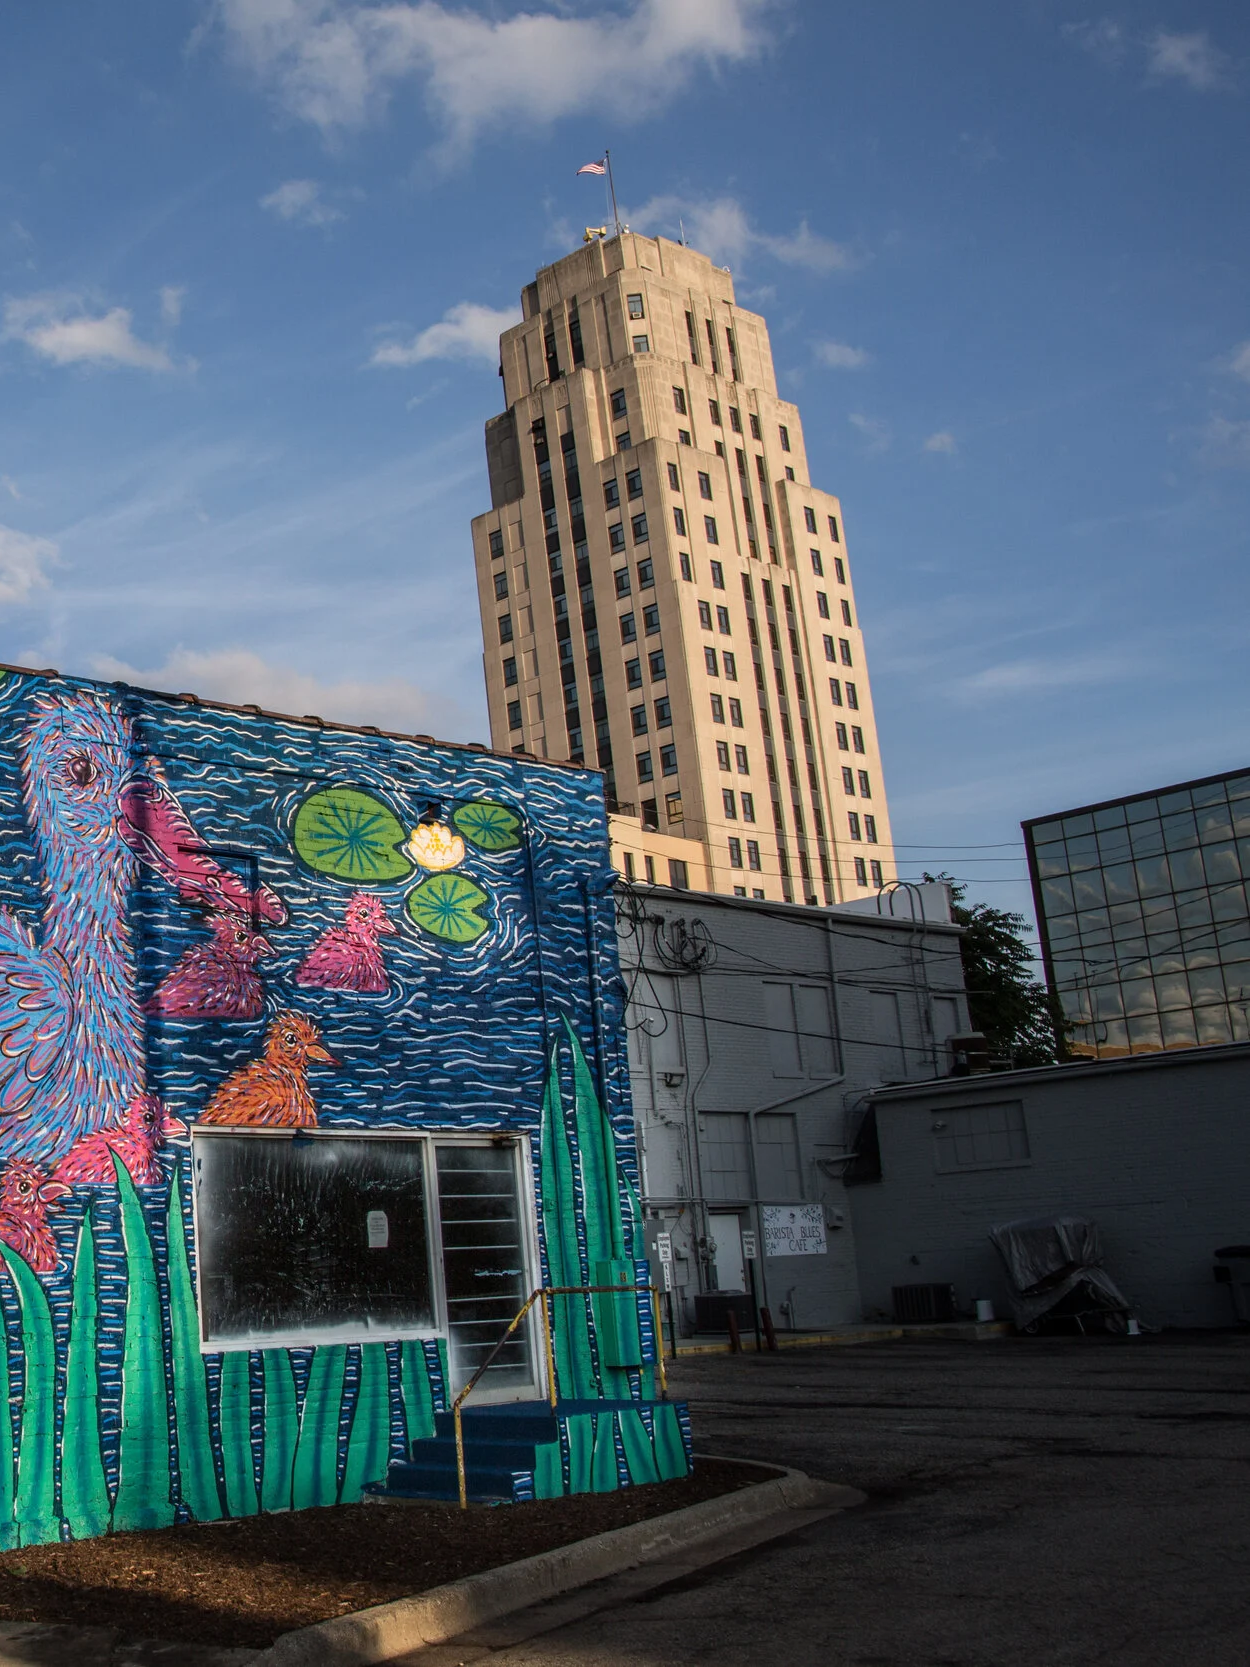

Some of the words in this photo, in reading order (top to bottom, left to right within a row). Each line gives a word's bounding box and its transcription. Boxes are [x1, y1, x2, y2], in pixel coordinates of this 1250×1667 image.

[764, 1227, 794, 1239] BARISTA
[800, 1225, 821, 1239] BLUES
[789, 1238, 809, 1252] CAFE
